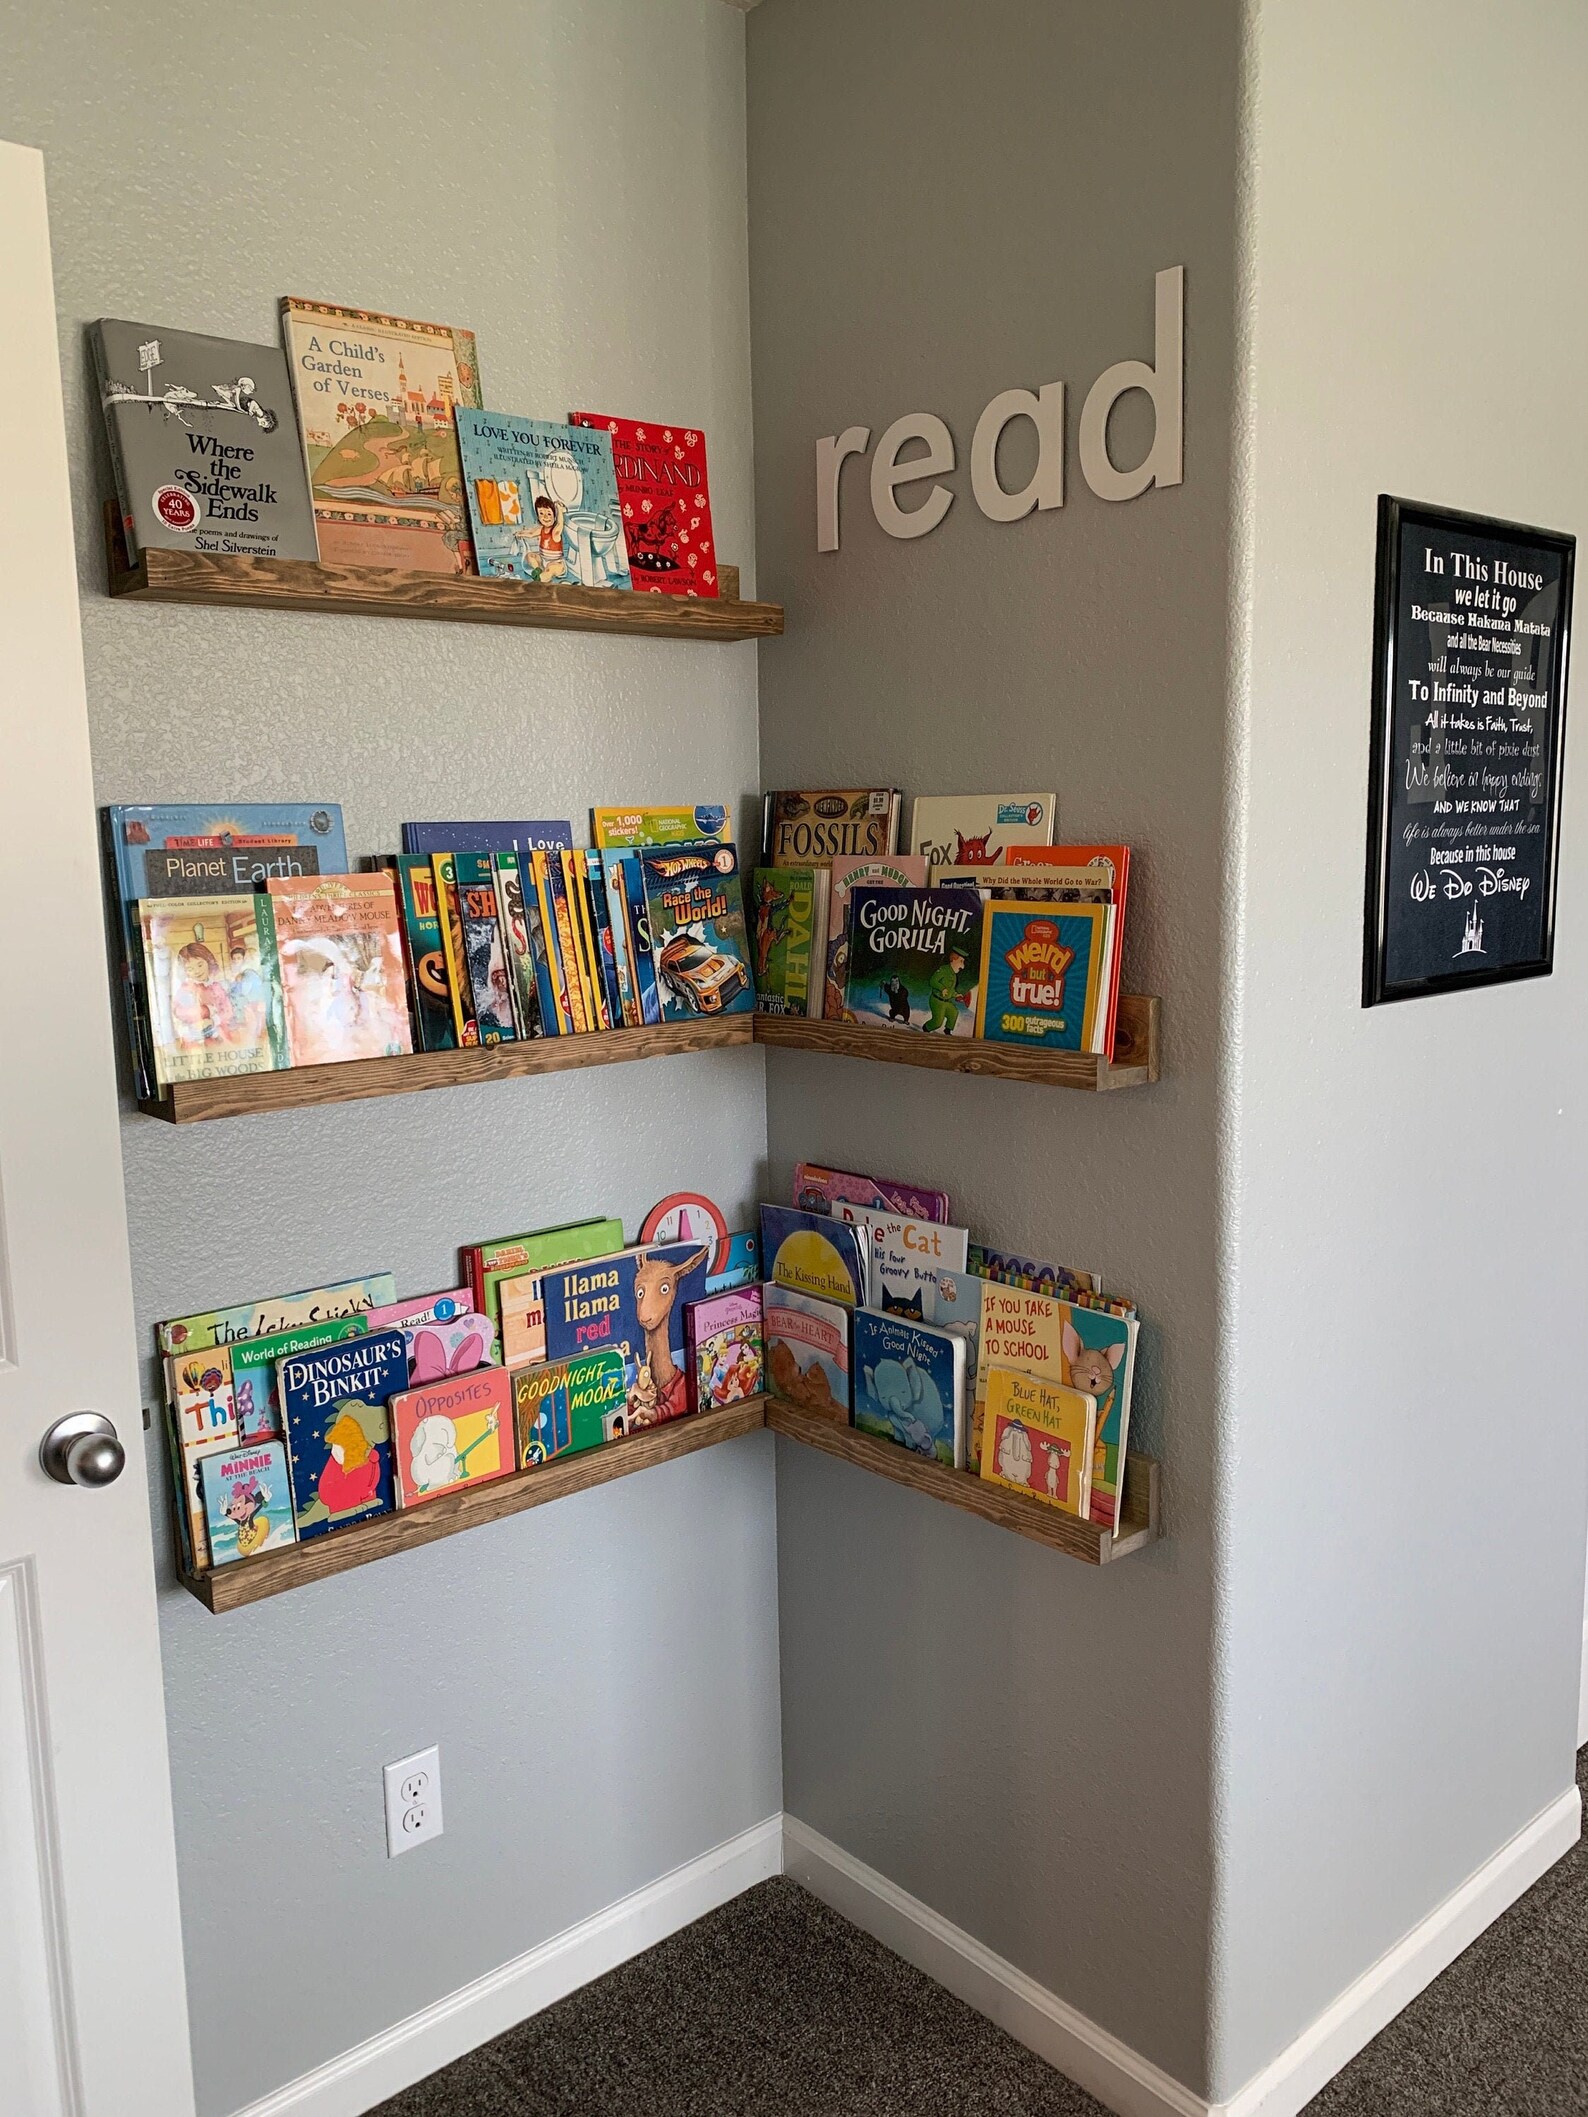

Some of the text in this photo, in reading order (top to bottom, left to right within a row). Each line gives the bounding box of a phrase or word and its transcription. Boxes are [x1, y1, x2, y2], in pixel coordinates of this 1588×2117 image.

[309, 336, 385, 363] A Child's
[301, 355, 363, 379] Garden
[313, 378, 390, 402] of Verses
[816, 265, 1183, 552] read
[185, 432, 255, 462] Where
[473, 424, 602, 456] LOVE YOU FOREVER
[209, 458, 241, 480] the
[613, 453, 701, 488] RDINAND
[174, 468, 278, 504] Sidewalk
[163, 508, 190, 518] YEARS
[168, 499, 183, 510] 40
[206, 498, 259, 523] Ends
[195, 536, 277, 557] Shel Silverstein
[1424, 547, 1543, 591] In This House
[1455, 585, 1517, 617] we let it go
[1411, 605, 1551, 637] Because Hakuna Matata
[1447, 633, 1522, 655] and all the Bear Necessities
[1428, 656, 1536, 685] will always be our guide
[1408, 679, 1548, 711] To Infinity and Beyond
[1425, 710, 1533, 734] All it takes is Faith, Trust,
[1412, 738, 1540, 760] and a little bit of pixie dust
[1405, 759, 1430, 790] We
[1433, 763, 1466, 790] believe
[1468, 771, 1479, 788] in
[1481, 766, 1509, 797] happy
[1434, 799, 1520, 813] AND WE KNOW THAT
[616, 815, 642, 826] 1,000
[1403, 820, 1540, 847] life is always better under the sea
[197, 838, 214, 846] LIFE
[527, 837, 565, 850] Love
[778, 822, 880, 856] FOSSILS
[664, 856, 727, 876] HOT WHEELS 1
[1430, 844, 1516, 866] Because in this house
[166, 855, 303, 884] Planet Earth
[982, 877, 996, 885] Why
[998, 877, 1009, 885] Did
[1021, 877, 1042, 885] Whole
[1043, 877, 1063, 885] World
[1085, 878, 1101, 886] War?
[663, 886, 712, 908] Race the
[675, 895, 727, 925] World!
[860, 896, 973, 935] GOOD NIGHT,
[784, 891, 812, 1008] DAHL
[869, 926, 946, 954] GORILLA
[1008, 942, 1071, 974] weird
[1030, 967, 1046, 980] but
[1013, 977, 1061, 1006] true!
[1002, 1015, 1064, 1031] 300 outrageous
[1027, 1024, 1044, 1034] facts
[887, 1223, 942, 1257] the Cat
[889, 1250, 906, 1263] four
[563, 1270, 620, 1298] llama
[777, 1262, 851, 1295] The Kissing Hand
[880, 1262, 909, 1279] Groovy
[400, 1311, 431, 1328] Read!
[442, 1303, 447, 1315] 1
[564, 1294, 621, 1323] llama
[704, 1316, 738, 1332] Princess
[740, 1307, 762, 1321] Magic
[984, 1296, 1053, 1318] IF YOU TAKE
[207, 1321, 248, 1345] The
[576, 1314, 611, 1344] red
[771, 1315, 793, 1330] BEAR
[986, 1318, 1036, 1336] A MOUSE
[241, 1334, 332, 1364] World of Reading
[869, 1322, 939, 1358] If Animals Kissed
[883, 1336, 931, 1366] Good Night
[985, 1339, 1049, 1360] TO SCHOOL
[287, 1339, 402, 1392] DINOSAUR'S
[311, 1367, 382, 1408] BINKIT
[518, 1361, 605, 1404] GOODNIGHT
[415, 1382, 492, 1418] OPPOSITES
[571, 1382, 616, 1411] MOON
[1012, 1382, 1060, 1412] BLUE HAT,
[1006, 1398, 1062, 1429] GREEN HAT
[221, 1454, 272, 1477] MINNIE
